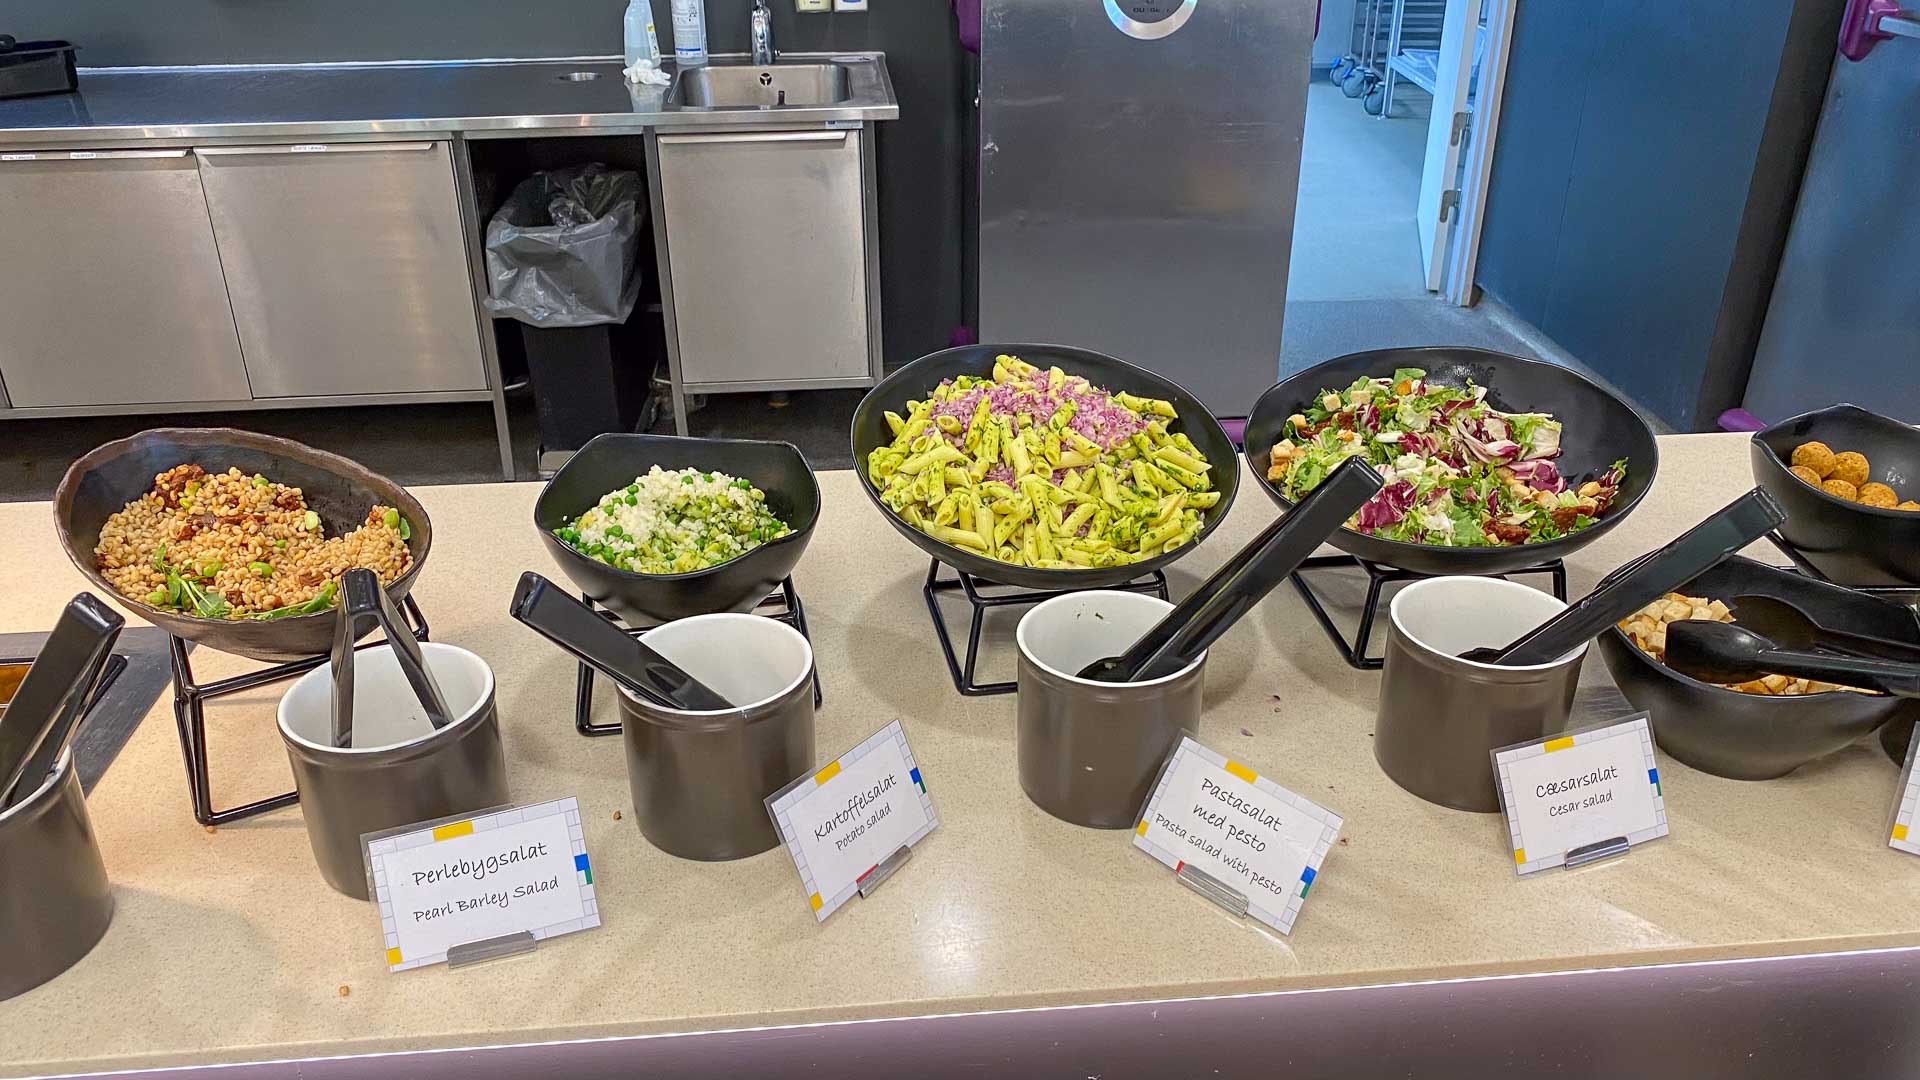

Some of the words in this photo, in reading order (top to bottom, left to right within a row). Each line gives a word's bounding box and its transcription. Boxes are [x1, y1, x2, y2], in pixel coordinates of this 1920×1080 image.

[1201, 778, 1282, 832] Pastasalat
[1536, 765, 1618, 798] Cæsarsalat
[1583, 790, 1613, 808] salad
[814, 773, 897, 842] Kartoffelsalat
[835, 824, 865, 851] Potato
[867, 803, 892, 829] salad
[1193, 804, 1225, 830] med
[1225, 824, 1266, 852] pesto
[412, 842, 548, 886] Perlebygsalat
[1155, 813, 1187, 838] Pasta
[1187, 834, 1220, 860] salad
[1223, 855, 1249, 877] with
[1249, 871, 1282, 895] pesto
[413, 902, 453, 922] Pearl
[456, 890, 509, 912] Barley
[513, 876, 559, 898] Salad
